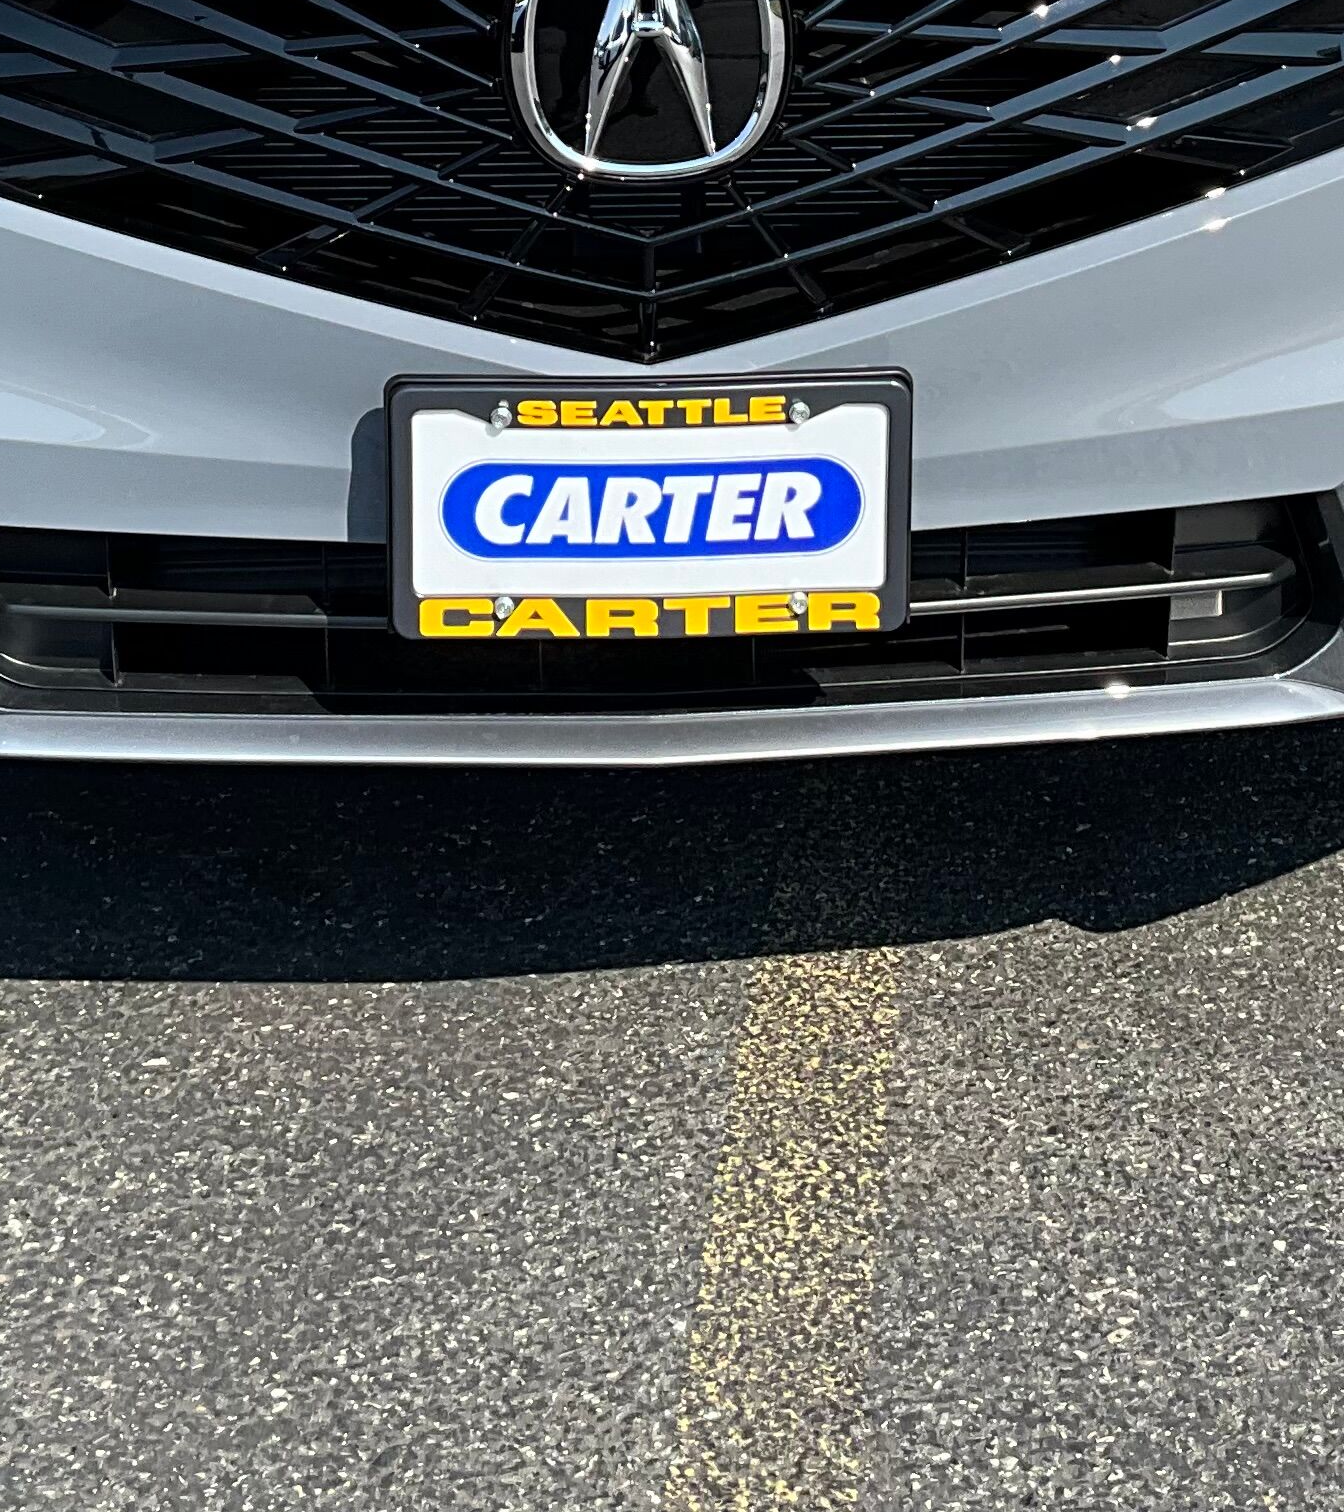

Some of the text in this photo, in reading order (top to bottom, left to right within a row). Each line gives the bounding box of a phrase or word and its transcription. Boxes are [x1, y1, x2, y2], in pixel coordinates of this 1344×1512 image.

[517, 395, 787, 427] SEATTLE
[474, 471, 822, 546] CARTER
[419, 591, 882, 638] CARTER
